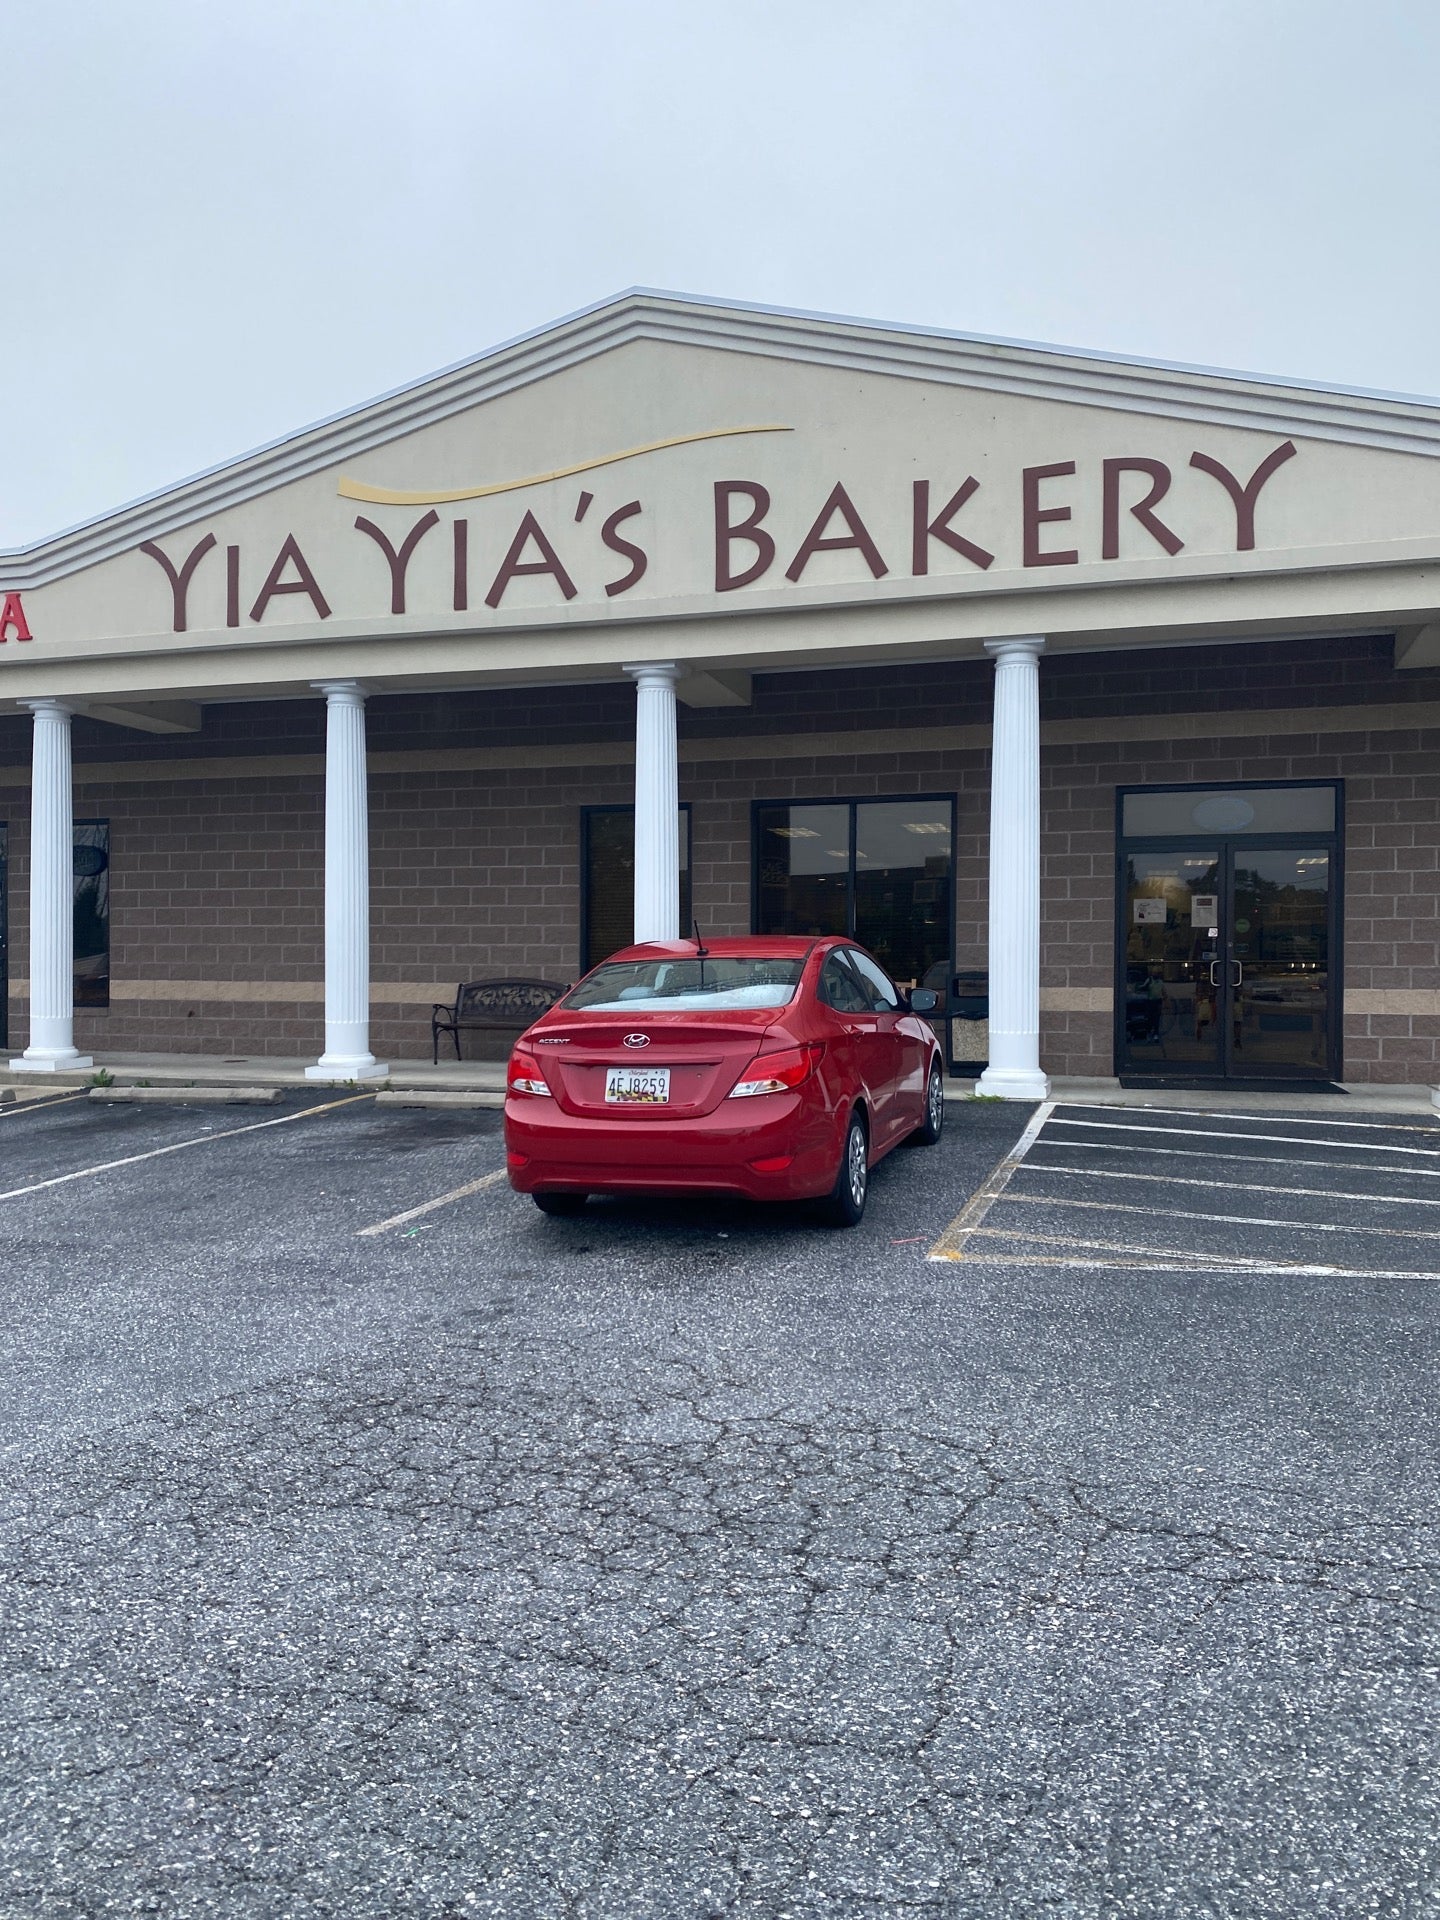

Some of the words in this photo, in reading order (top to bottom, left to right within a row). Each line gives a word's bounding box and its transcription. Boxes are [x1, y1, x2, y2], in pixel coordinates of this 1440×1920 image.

[139, 532, 332, 632] YIA
[354, 490, 648, 614] YIA'S
[714, 440, 1297, 592] BAKERY
[608, 1077, 666, 1096] 4EJ8259
